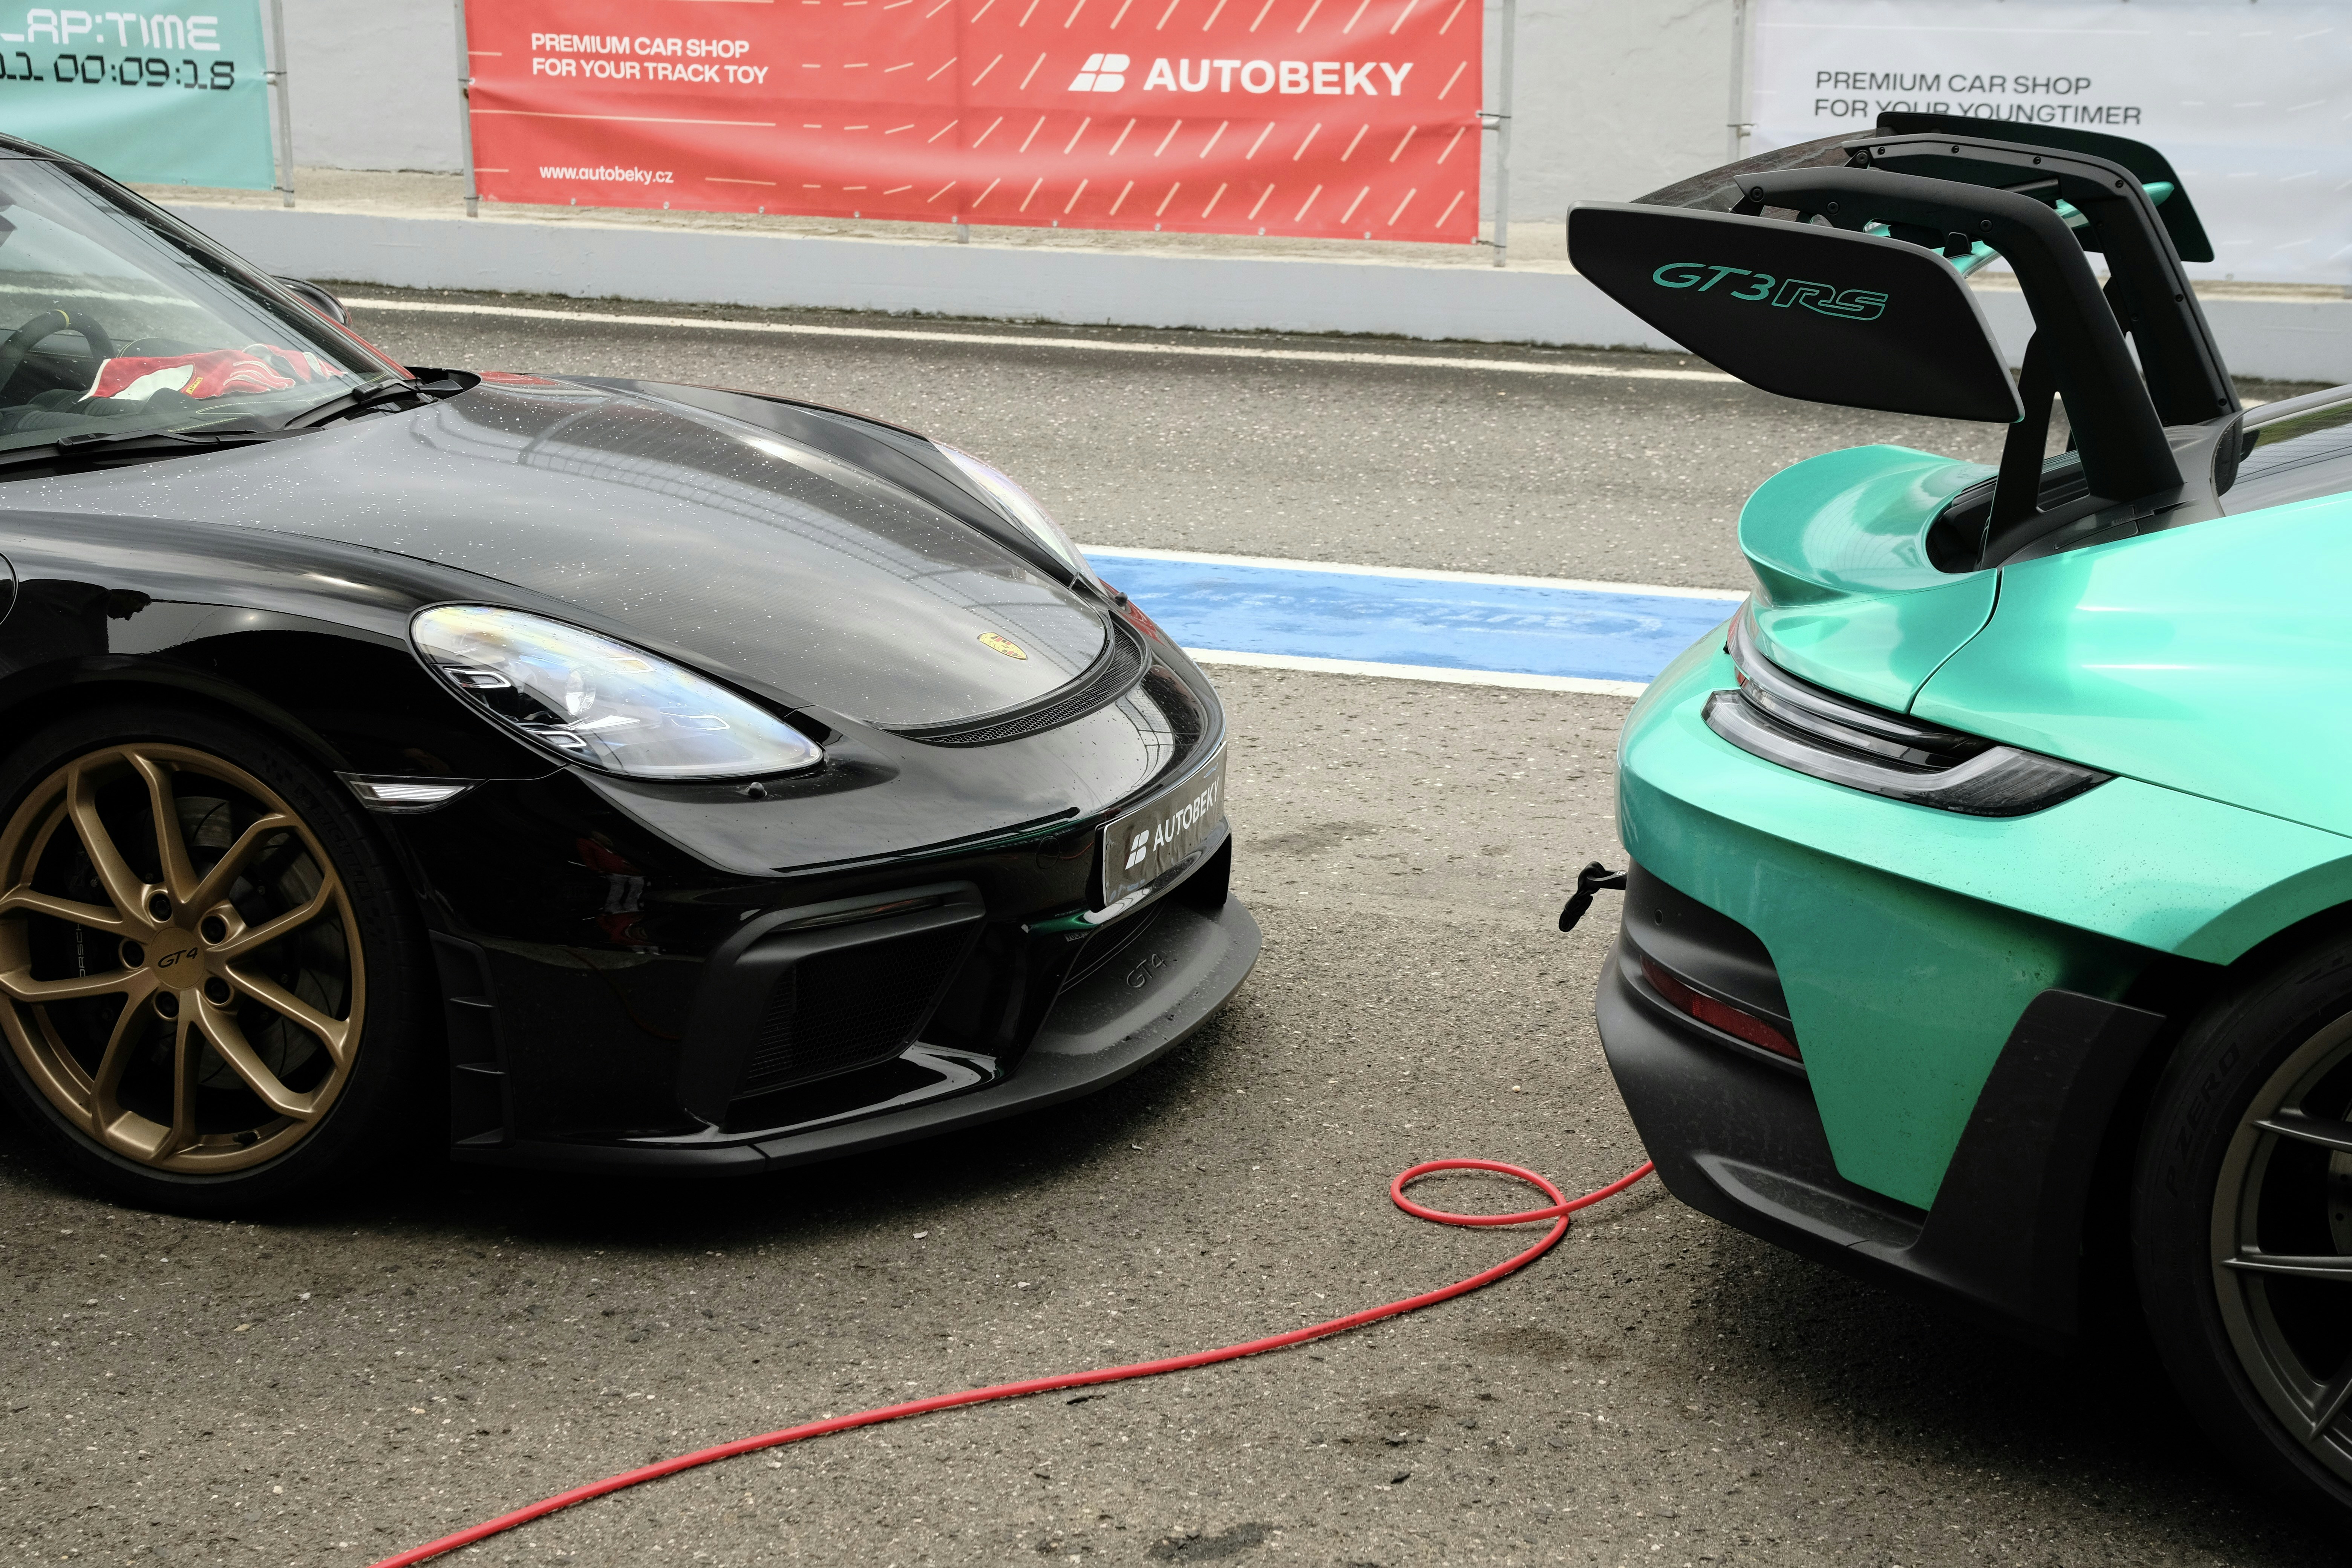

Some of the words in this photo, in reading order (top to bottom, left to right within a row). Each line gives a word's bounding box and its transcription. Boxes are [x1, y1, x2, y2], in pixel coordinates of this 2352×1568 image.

[531, 33, 630, 54] PREMIUM
[634, 37, 682, 56] CAR
[686, 39, 749, 58] SHOP
[54, 54, 234, 90] 00:09:18
[533, 57, 576, 77] FOR
[580, 60, 640, 79] YOUR
[644, 62, 720, 83] TRACK
[724, 65, 769, 84] TOY
[1143, 58, 1413, 96] AUTOBEKY
[1815, 71, 1941, 91] PREMIUM
[1948, 75, 2007, 93] CAR
[2014, 76, 2091, 95] SHOP
[1815, 99, 1868, 117] FOR
[1958, 103, 2141, 125] YOUNGTIMER
[539, 165, 674, 185] www.autobeky.cz
[1153, 776, 1219, 852] AUTOBEKY
[158, 947, 198, 968] GT4
[1126, 954, 1167, 989] GT4
[2173, 1041, 2241, 1160] ZERO
